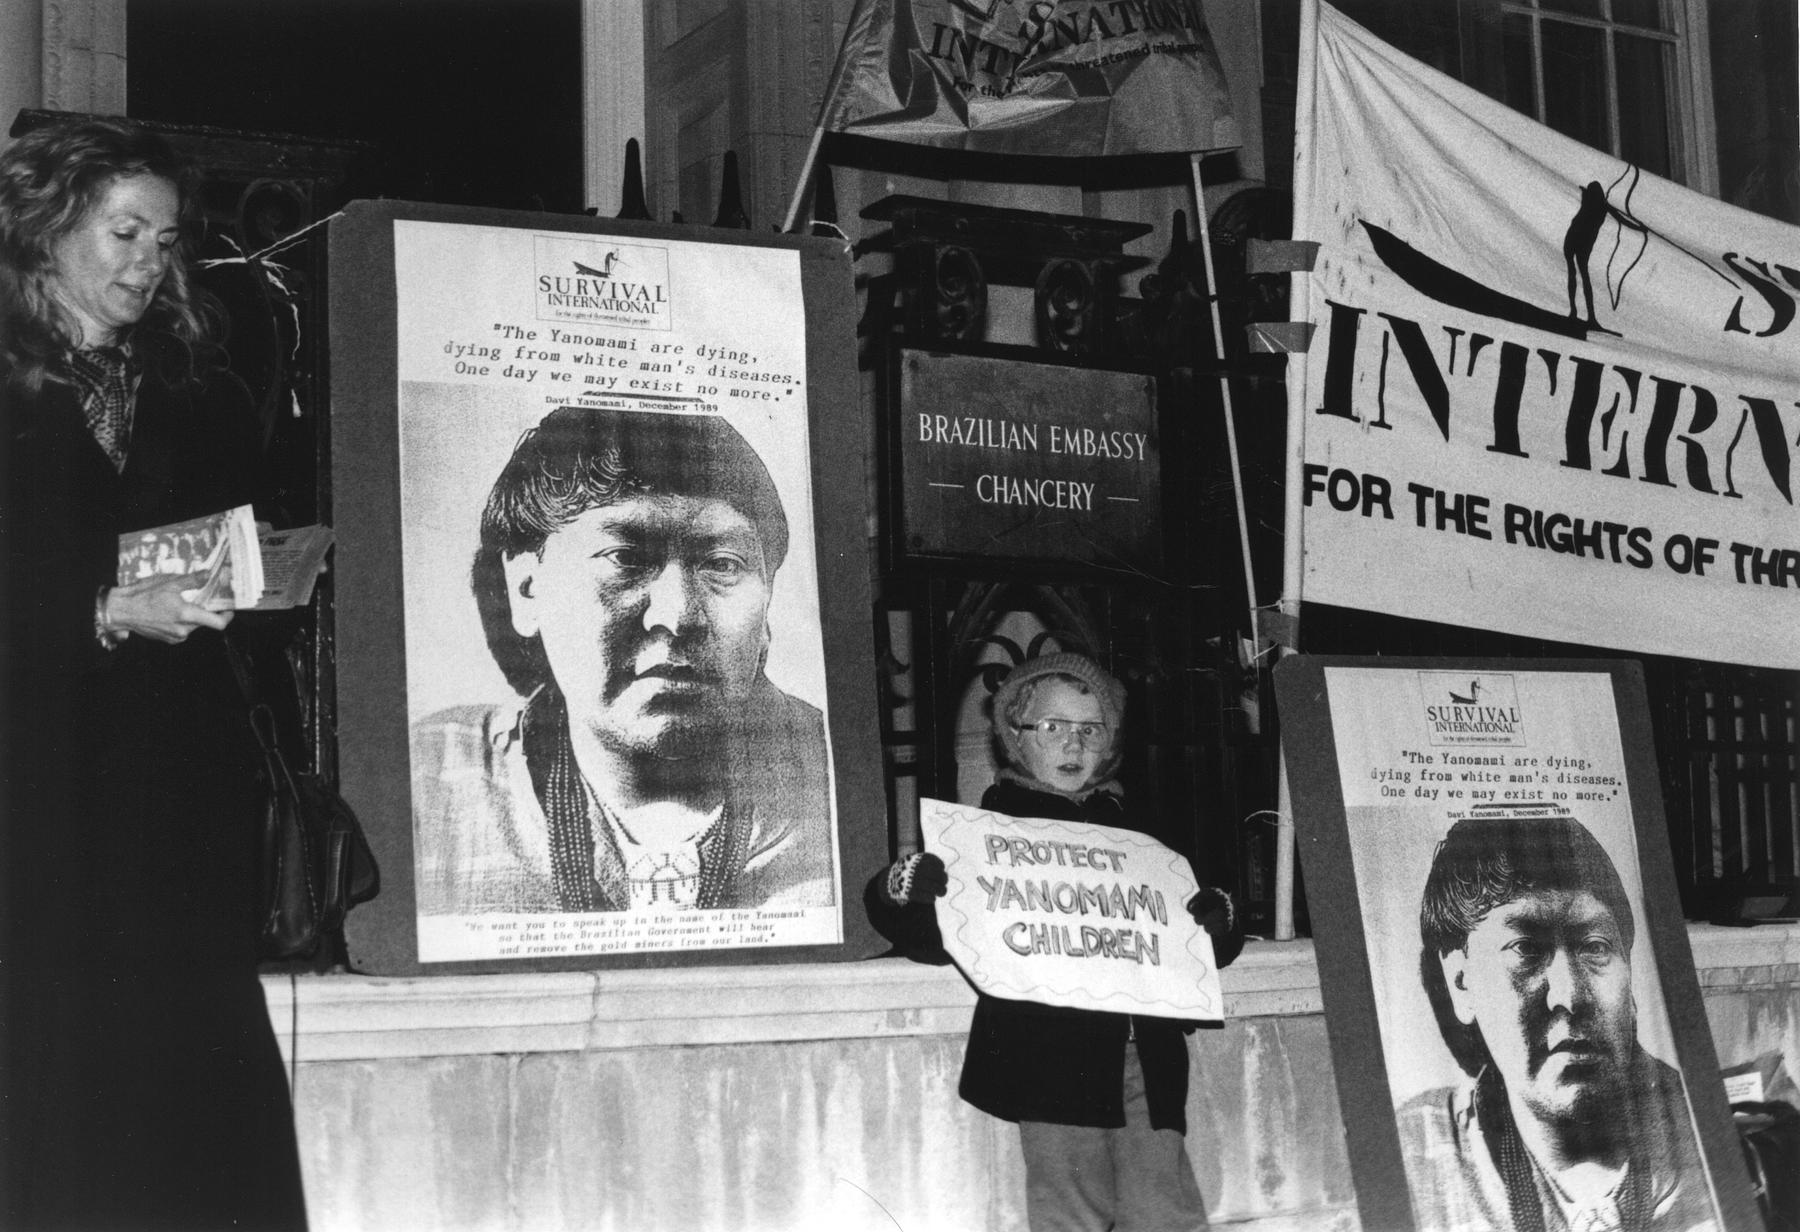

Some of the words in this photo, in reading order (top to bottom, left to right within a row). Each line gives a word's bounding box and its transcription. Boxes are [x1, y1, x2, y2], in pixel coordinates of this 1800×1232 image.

[539, 275, 667, 303] SURVIVAL
[548, 293, 659, 314] INTERNATIONAL
[494, 323, 537, 340] "The
[551, 329, 637, 351] Yanomami
[651, 343, 684, 354] are
[696, 344, 758, 364] dying,
[444, 341, 501, 361] dying
[515, 346, 560, 361] from
[573, 352, 628, 368] white
[640, 360, 695, 375] man's
[708, 365, 801, 385] diseases.
[455, 361, 490, 376] One
[503, 365, 538, 382] day
[550, 371, 572, 382] we
[584, 374, 618, 389] may
[629, 379, 683, 392] exist
[697, 385, 718, 396] no
[545, 396, 570, 405] Davi
[639, 401, 687, 411] December
[695, 403, 719, 412] 1989
[918, 413, 1038, 451] BRAZILIAN
[1050, 425, 1148, 461] EMBASSY
[976, 474, 1096, 511] CHANCERY
[1302, 462, 1395, 520] FOR
[1408, 482, 1492, 541] THE
[1504, 502, 1654, 569] RIGHTS
[1664, 534, 1720, 576] OF
[1427, 706, 1519, 723] SURVIVAL
[1435, 721, 1516, 734] INTERNATIONAL
[1402, 750, 1434, 764] "The
[1441, 752, 1506, 766] Yanomami
[1514, 757, 1538, 767] are
[1547, 755, 1592, 770] dying,
[1371, 768, 1411, 783] dying
[1420, 769, 1453, 781] from
[1461, 771, 1501, 782] white
[1509, 771, 1549, 783] man's
[1557, 772, 1622, 786] diseases.
[1381, 785, 1406, 797] One
[1414, 786, 1439, 800] day
[1447, 790, 1463, 798] we
[1472, 790, 1496, 801] may
[1504, 789, 1544, 800] exist
[984, 834, 1127, 873] PROTECT
[976, 875, 1168, 926] YANOMAMI
[491, 922, 518, 931] want
[526, 922, 545, 931] you
[553, 920, 566, 929] to
[573, 918, 606, 930] speak
[613, 918, 627, 928] up
[654, 915, 673, 924] the
[679, 915, 704, 923] name
[731, 913, 749, 921] the
[519, 932, 545, 941] that
[554, 931, 573, 940] the
[580, 929, 640, 940] Brazilian
[648, 925, 711, 936] Government
[719, 923, 743, 932] will
[751, 923, 775, 931] hear
[527, 945, 567, 954] remove
[575, 943, 594, 951] the
[601, 941, 627, 952] gold
[635, 940, 673, 949] miners
[680, 938, 706, 946] from
[1002, 921, 1160, 966] CHILDREN
